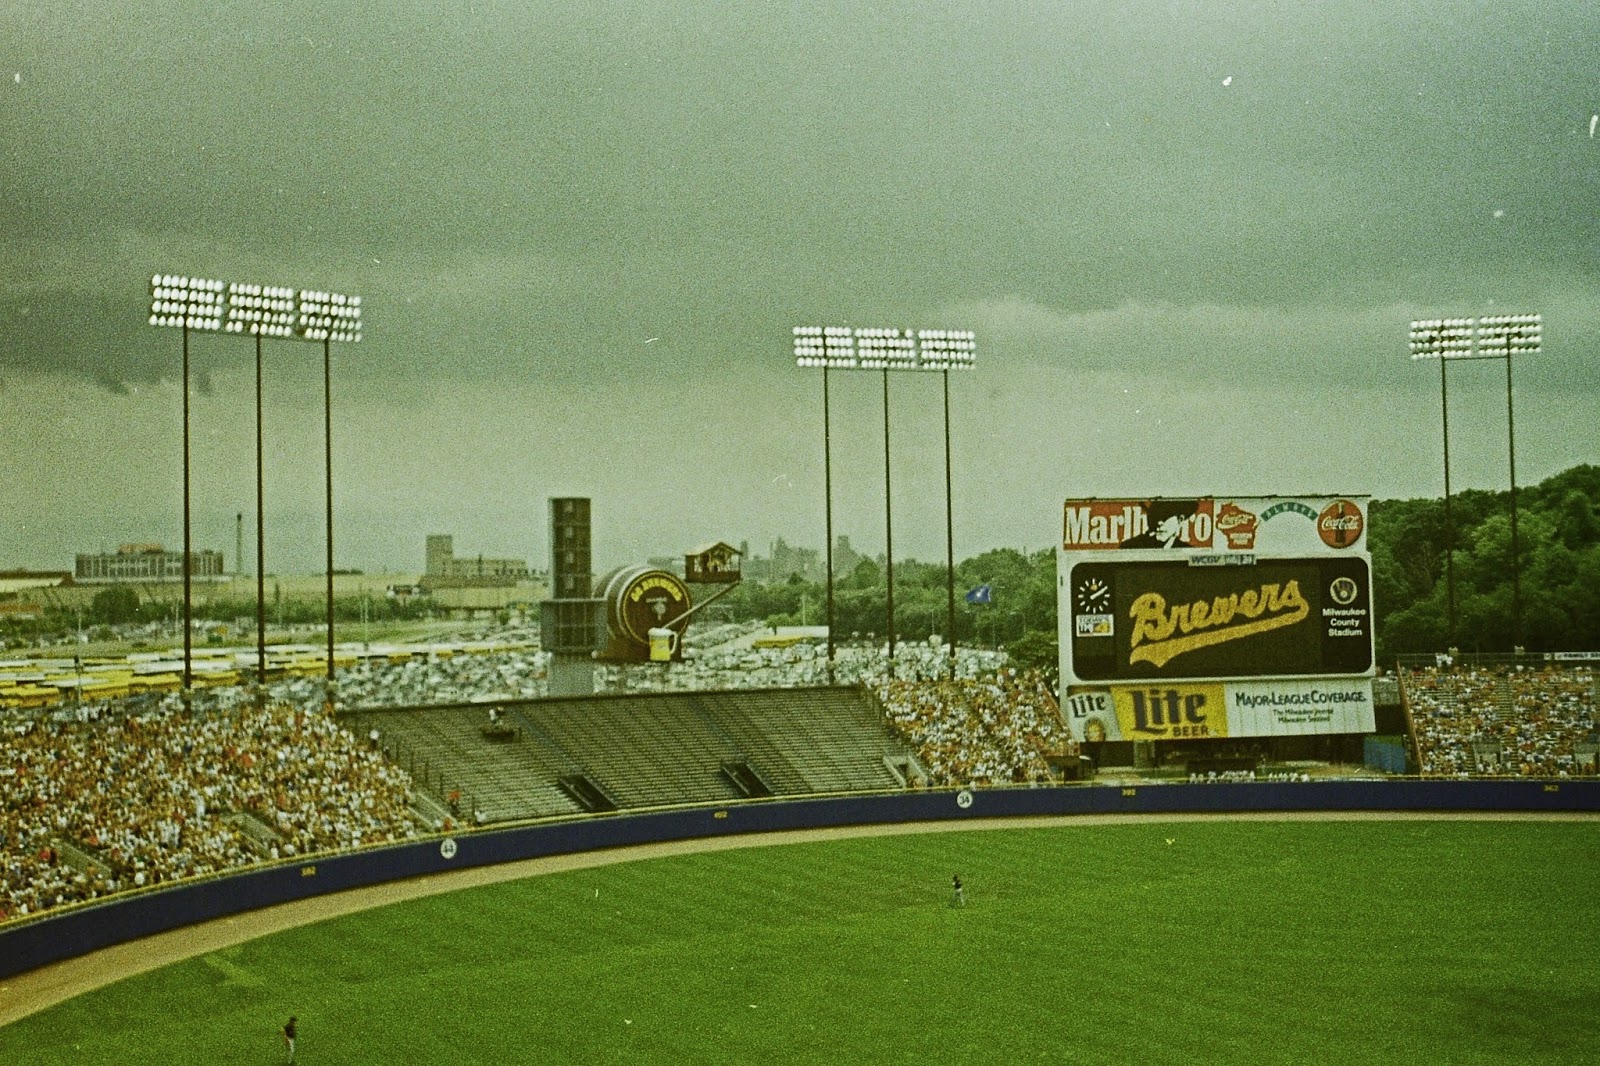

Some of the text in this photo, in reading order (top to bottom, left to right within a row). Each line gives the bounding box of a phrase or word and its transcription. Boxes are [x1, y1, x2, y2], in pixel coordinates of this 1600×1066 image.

[1064, 506, 1212, 544] Marlbro
[1129, 578, 1309, 649] Brewers
[1322, 608, 1366, 617] Milwaukee
[1330, 618, 1360, 628] County
[1328, 628, 1363, 637] Stadium
[1069, 694, 1107, 718] Lite
[1127, 689, 1207, 735] Lite
[1173, 725, 1209, 736] BEER
